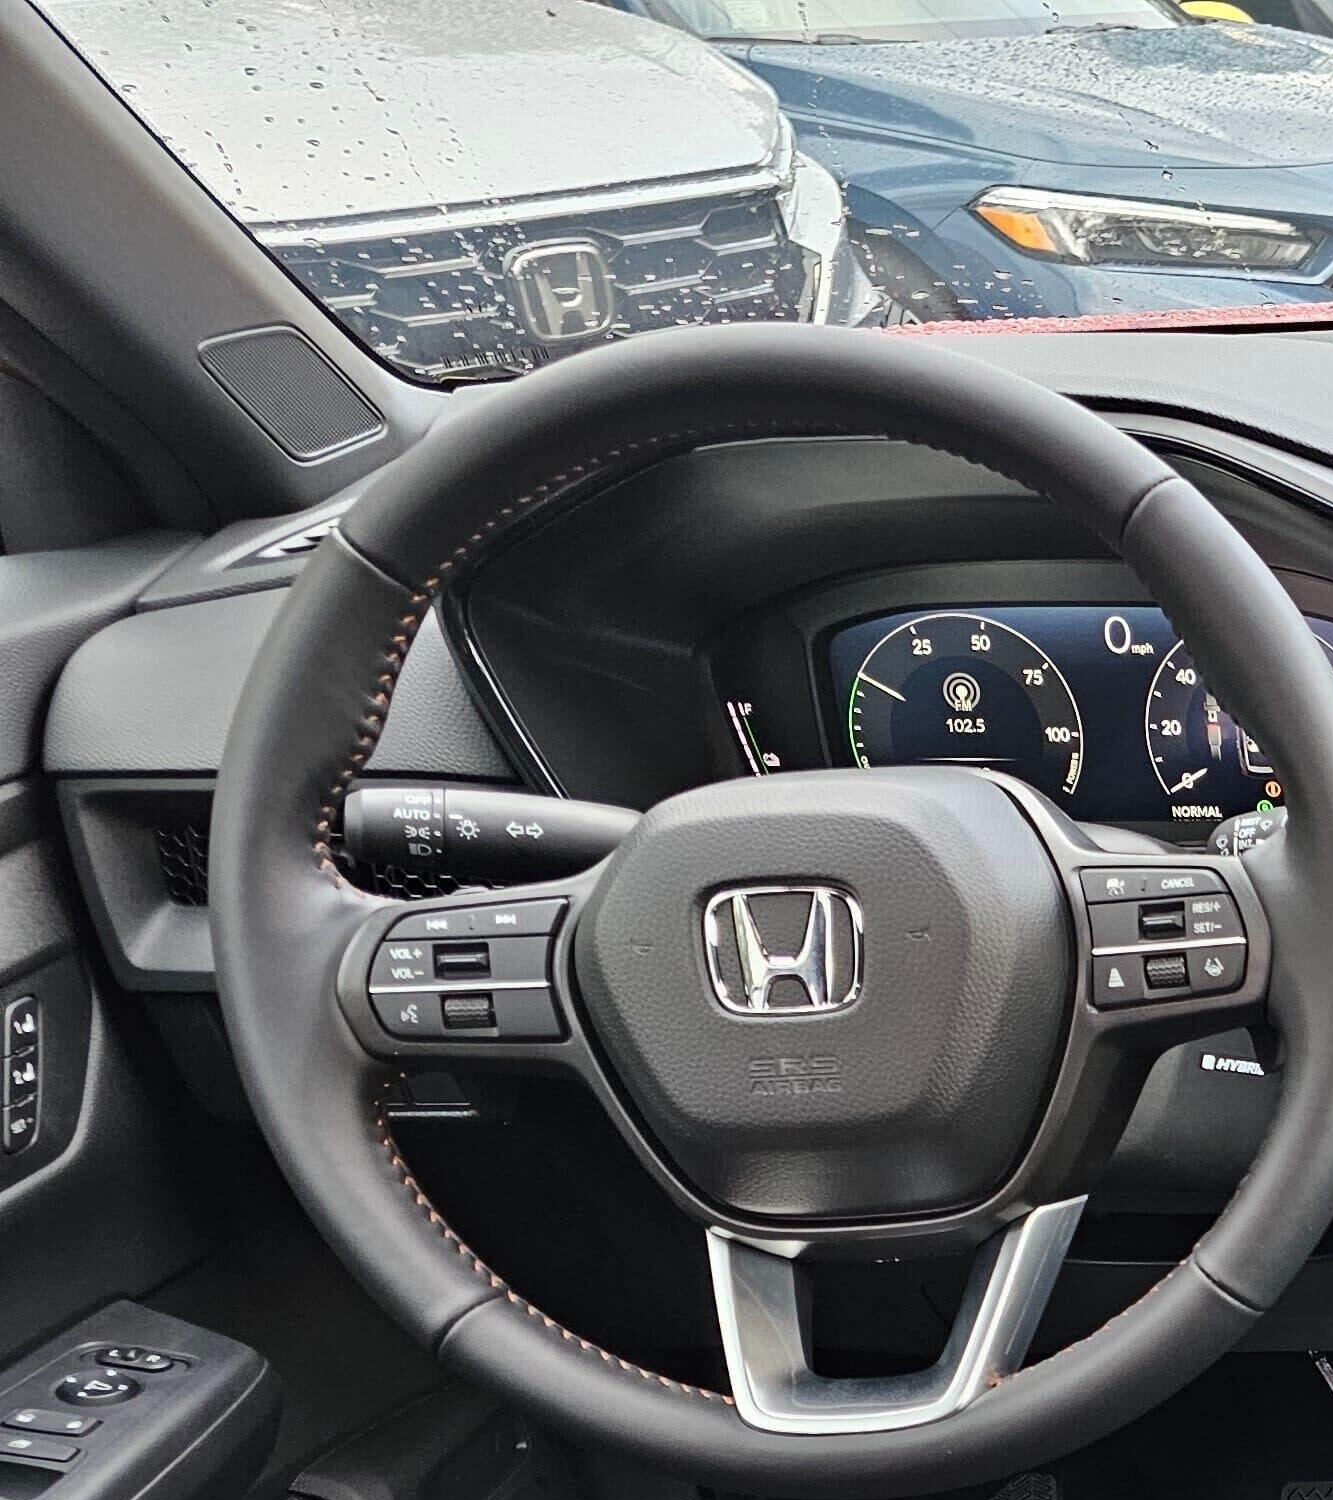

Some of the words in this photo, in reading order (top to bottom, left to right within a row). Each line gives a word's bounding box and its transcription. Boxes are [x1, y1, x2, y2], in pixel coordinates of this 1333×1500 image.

[971, 635, 990, 650] 50
[1105, 616, 1131, 653] 0
[1132, 643, 1154, 655] mph
[912, 639, 932, 655] 25
[1022, 669, 1043, 685] 75
[1175, 669, 1196, 684] 40
[955, 701, 972, 711] FM
[946, 719, 986, 733] 102.5
[1161, 720, 1181, 735] 20
[1045, 727, 1070, 742] 100
[393, 808, 430, 820] AUTO
[1172, 806, 1223, 818] NORMAL
[1239, 828, 1256, 838] OFF
[1161, 877, 1195, 889] CANCEL
